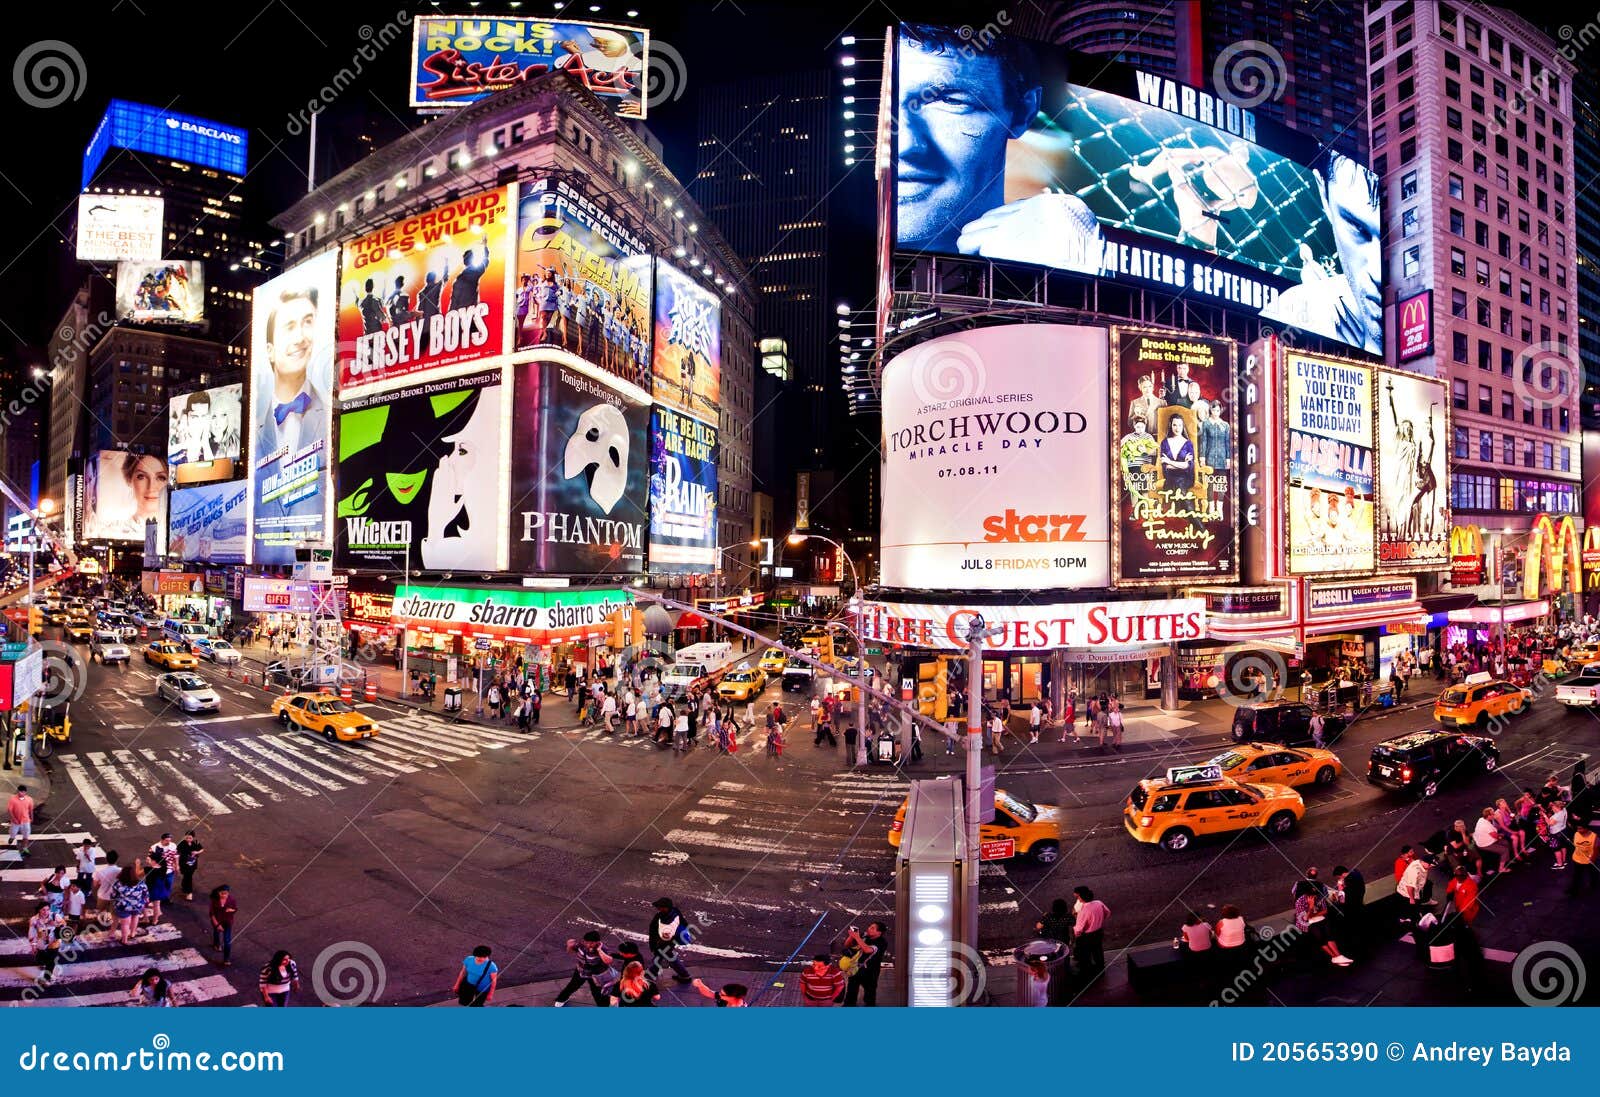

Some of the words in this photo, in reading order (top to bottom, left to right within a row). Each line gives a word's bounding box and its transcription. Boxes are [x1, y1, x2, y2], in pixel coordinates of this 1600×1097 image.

[429, 21, 554, 39] NUNS
[554, 53, 641, 92] Act
[1135, 70, 1257, 144] WARRIOR
[181, 121, 241, 145] BARCLAYS
[402, 193, 501, 236] CROWD
[539, 192, 641, 257] SPECTACULAR
[556, 181, 646, 253] SPECTACULAR
[86, 230, 114, 240] THE
[118, 231, 155, 241] BEST
[521, 217, 614, 282] CATCH
[350, 318, 425, 376] JERSEY
[429, 303, 489, 357] BOYS
[1141, 338, 1176, 351] Brooke
[1177, 341, 1211, 355] Shields
[1402, 342, 1428, 356] HOURS
[1138, 349, 1162, 361] joins
[1163, 351, 1181, 362] the
[1181, 352, 1214, 368] family!
[1297, 361, 1364, 386] EVERYTHING
[424, 380, 458, 394] DOROTHY
[560, 368, 588, 393] Tonight
[588, 381, 615, 405] belongs
[1305, 379, 1327, 396] YOU
[1330, 383, 1356, 400] EVER
[917, 407, 923, 415] A
[923, 401, 948, 415] STARZ
[949, 395, 994, 409] ORIGINAL
[996, 393, 1033, 404] SERIES
[1300, 394, 1344, 415] WANTED
[1347, 402, 1362, 417] ON
[680, 416, 716, 447] BEATLES
[891, 411, 1088, 452] TORCHWOOD
[1301, 412, 1361, 433] BROADWAY!
[665, 431, 684, 454] ARE
[909, 440, 984, 461] MIRACLE
[1002, 438, 1044, 449] DAY
[1246, 354, 1257, 526] PALACE
[1289, 430, 1373, 477] PRISCILLA
[938, 465, 999, 478] 07.08.11
[665, 454, 707, 517] RAIN
[1158, 488, 1197, 503] The
[346, 516, 412, 545] WICKED
[521, 511, 642, 549] PHANTOM
[982, 508, 1088, 542] starz
[1142, 520, 1215, 550] Family
[1380, 541, 1448, 560] CHICAGO
[961, 559, 984, 571] JUL
[985, 559, 993, 570] 8
[994, 558, 1051, 570] FRIDAYS
[1053, 557, 1088, 569] 10PM
[160, 581, 189, 591] GIFTS
[1312, 589, 1353, 605] PRISCILLA
[266, 594, 290, 604] GIFTS
[400, 595, 455, 620] sbarro
[469, 600, 538, 627] sbarro
[549, 601, 594, 628] sbarro
[1087, 606, 1201, 644] SUITES
